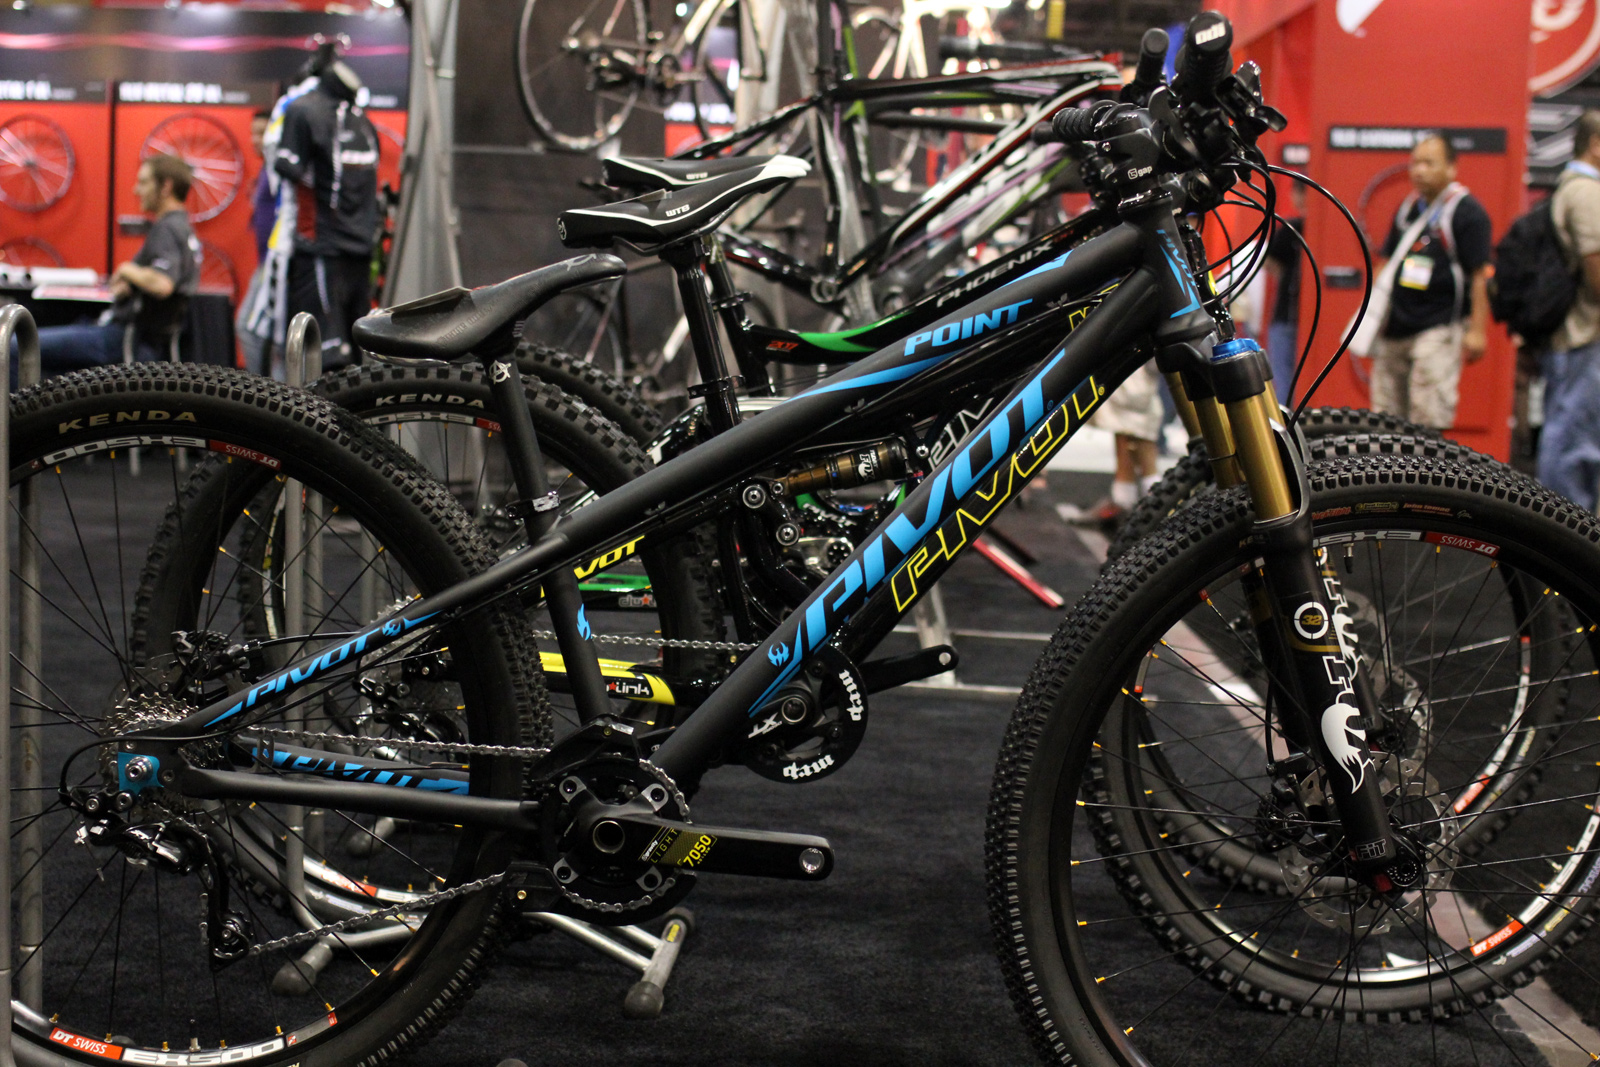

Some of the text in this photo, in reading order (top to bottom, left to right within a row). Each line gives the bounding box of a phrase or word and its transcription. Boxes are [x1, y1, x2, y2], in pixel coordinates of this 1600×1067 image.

[1195, 21, 1227, 46] odi
[665, 204, 690, 217] WTB
[937, 241, 1053, 308] PHOENIX
[904, 298, 1014, 356] POINT
[375, 393, 485, 409] KENDA
[58, 410, 197, 434] KENDA
[43, 435, 207, 466] EX500
[225, 444, 280, 468] DT SWISS
[805, 347, 1066, 652] PIVOT
[573, 535, 646, 580] VOT
[1440, 535, 1497, 555] DT SWISS
[1301, 614, 1322, 626] 32
[246, 628, 380, 707] PIVOT
[839, 669, 864, 721] mrp
[783, 754, 835, 780] mrp
[650, 828, 679, 864] LIGHT
[683, 834, 712, 868] 7050
[1489, 926, 1513, 947] SWISS
[53, 1029, 108, 1055] DT SWISS
[121, 1038, 284, 1066] EX500
